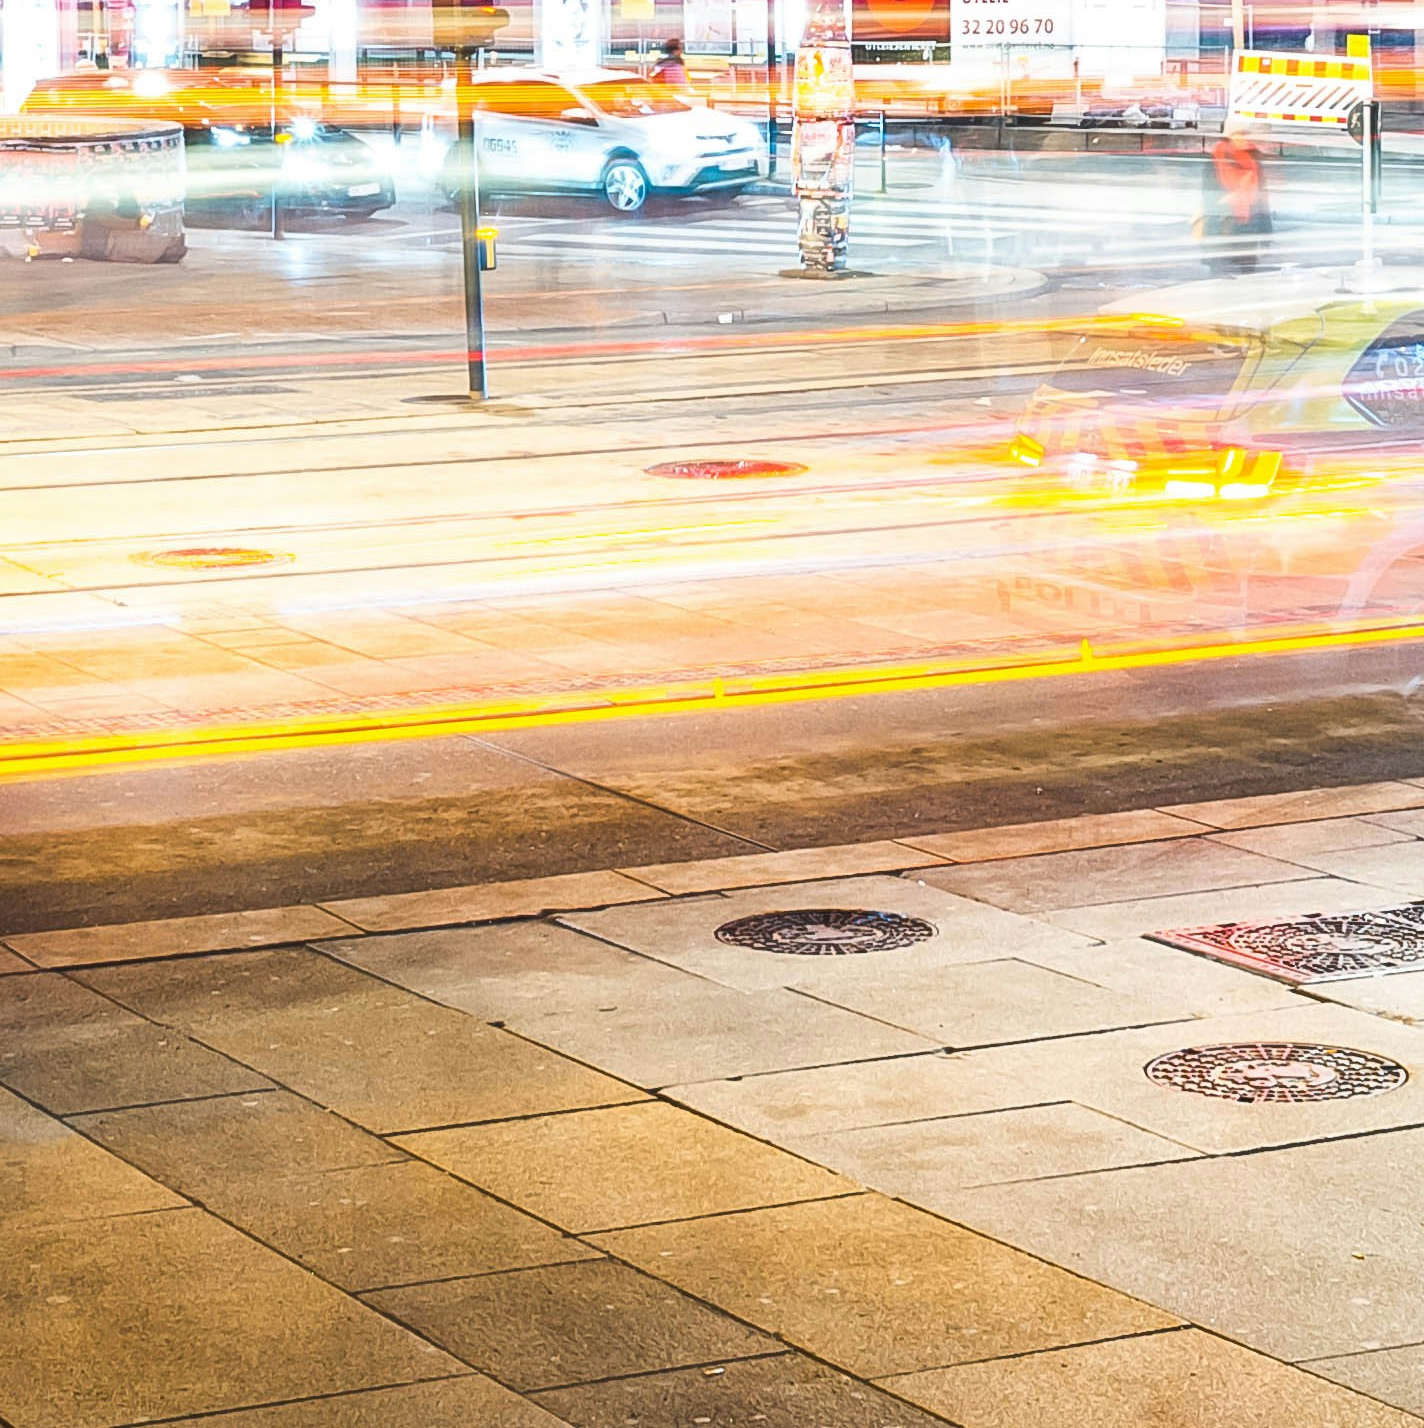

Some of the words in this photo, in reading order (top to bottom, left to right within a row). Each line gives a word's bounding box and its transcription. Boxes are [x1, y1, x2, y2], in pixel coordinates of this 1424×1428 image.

[961, 20, 980, 35] 32
[985, 19, 1006, 35] 20
[1009, 19, 1030, 34] 96
[1034, 18, 1055, 34] 70
